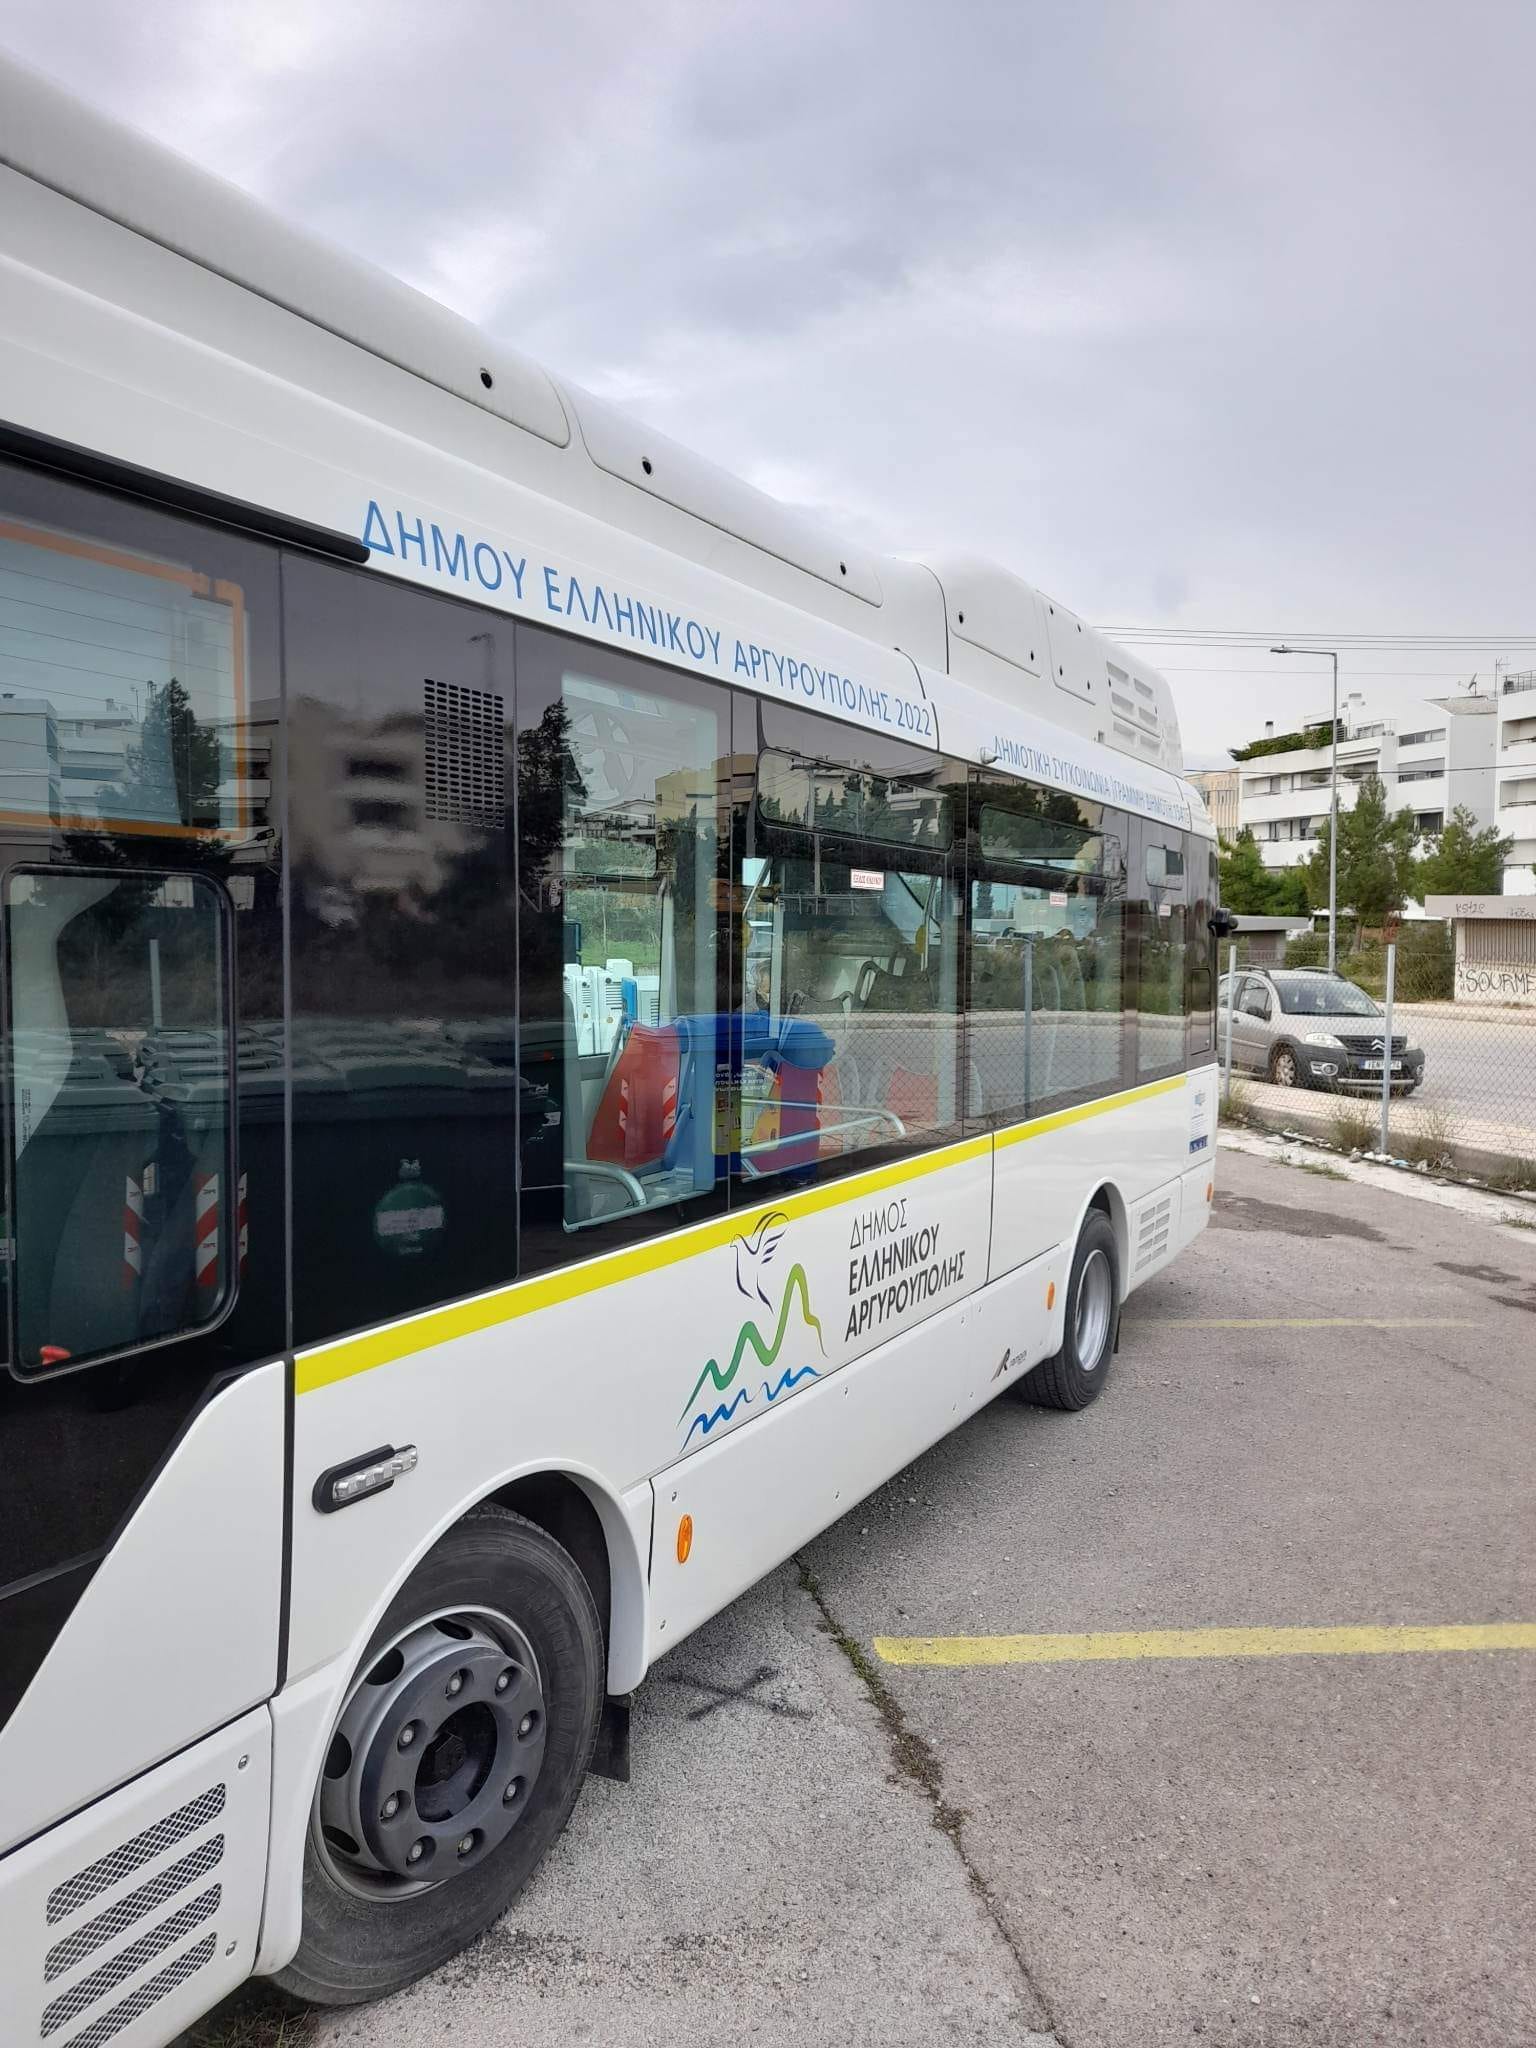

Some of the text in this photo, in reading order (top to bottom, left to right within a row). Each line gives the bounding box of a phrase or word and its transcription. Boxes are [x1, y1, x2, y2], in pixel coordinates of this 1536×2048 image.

[362, 500, 933, 736] ΔΗΜΟΥ ΕΛΛΗΝΙΚΟΥ ΑΡΓΥΡΟΥΠΟΛΗΣ 2022
[993, 735, 1051, 777] ΔΗΜΟΤΙΚΗ
[1052, 757, 1111, 797] ΣΥΓΚΟΙΝΩΝΙΑ
[848, 1223, 940, 1296] ΕΛΛΗΝΙΚΟΥ
[849, 1198, 908, 1250] ΔΗΜΟΣ
[844, 1250, 966, 1343] ΑΡΓΥΡΟΥΠΟΛΗΣ
